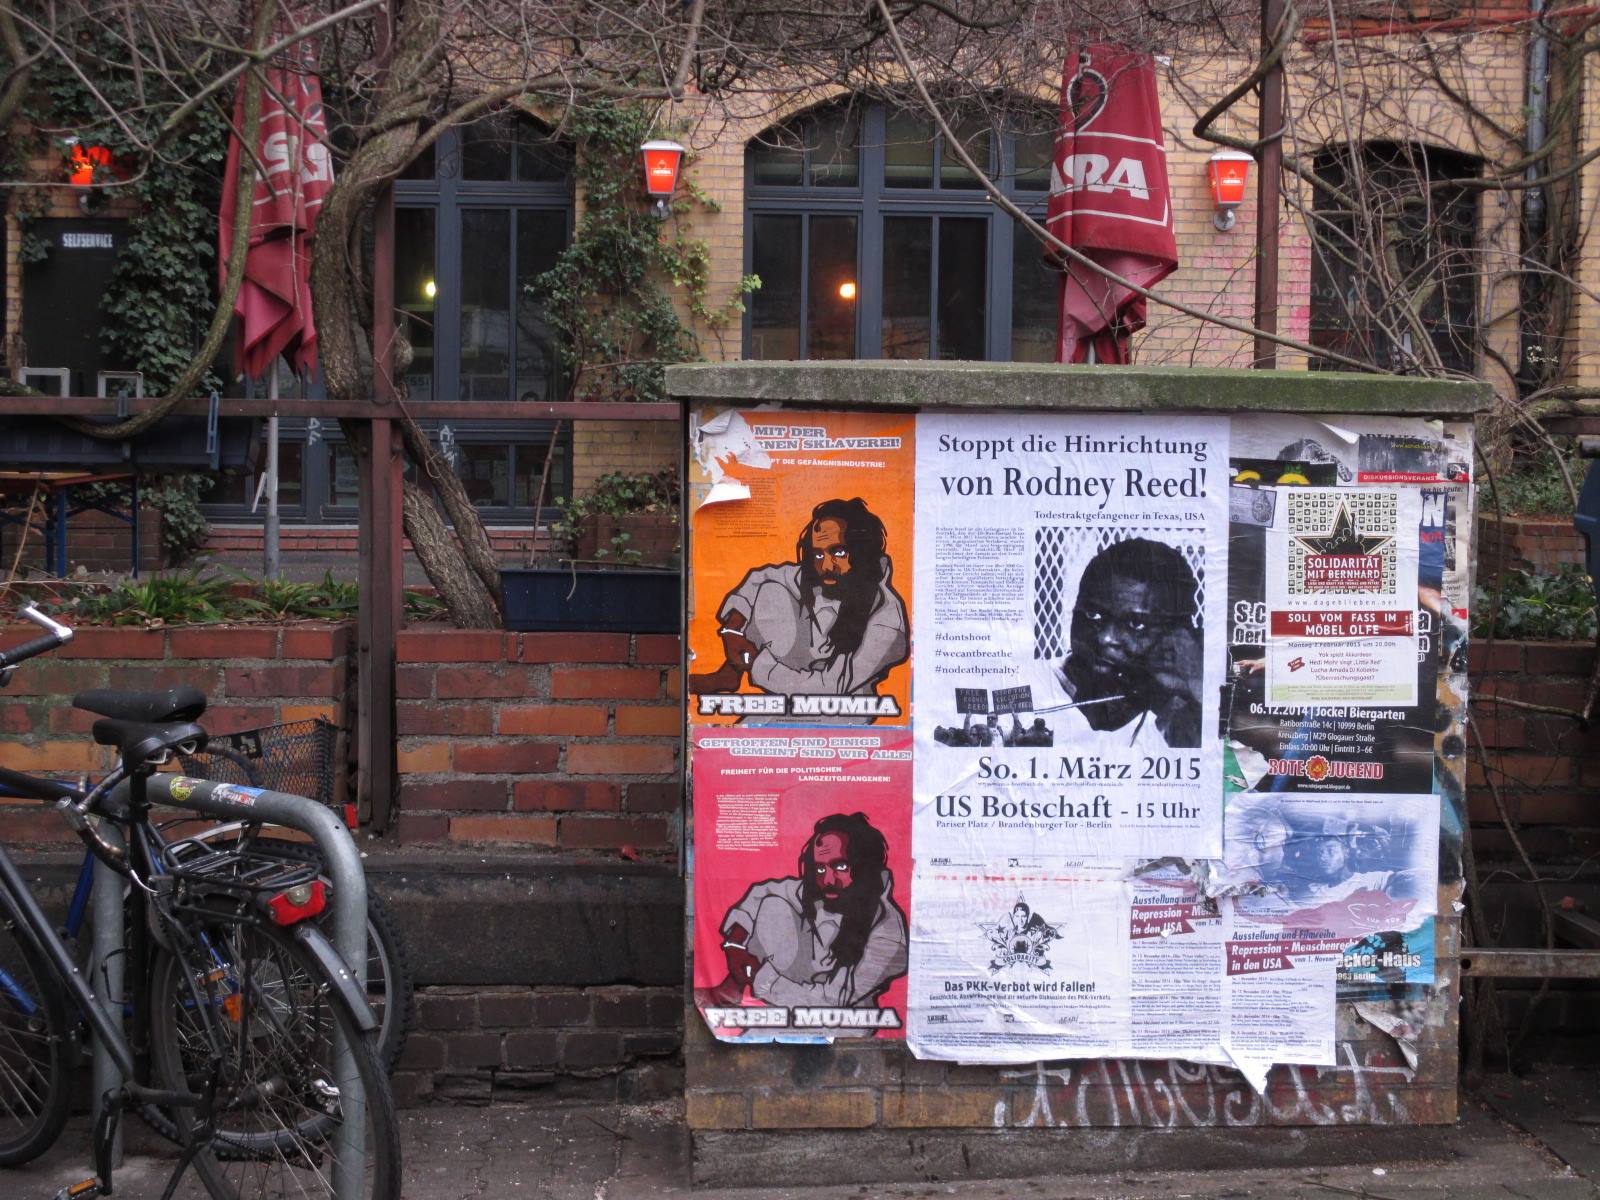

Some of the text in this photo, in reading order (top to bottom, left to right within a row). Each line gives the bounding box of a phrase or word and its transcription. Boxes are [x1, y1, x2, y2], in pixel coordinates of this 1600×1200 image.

[753, 426, 826, 438] MIT DER
[803, 437, 900, 449] SKLAVEREI!
[938, 433, 1208, 462] Stoppt die Hinrichtung
[940, 466, 1208, 509] von Rodney Reed!
[1034, 510, 1206, 523] Todestraktgefangener in Texas, USA
[1308, 556, 1379, 569] SOLIDARITÄT
[1308, 570, 1380, 579] MIT BERNHARD
[1288, 613, 1397, 622] SOLI VOM FASS IM
[1305, 624, 1380, 635] MÖBEL OLFE
[935, 632, 991, 642] #dontshoot
[935, 649, 1012, 658] #wecantbreathe
[700, 695, 900, 715] FREE MUMIA
[1250, 703, 1405, 721] 06.12.2014 Jockel Biergarten
[1357, 722, 1375, 731] Berlin
[700, 738, 880, 748] GETROFFEN SIND EINIGE
[1313, 732, 1327, 740] M29
[1328, 733, 1355, 743] Glogauer
[1356, 733, 1376, 742] Straße
[731, 747, 912, 760] GEMEINT SIND WIR ALLE!
[1319, 744, 1330, 752] Uhr
[1334, 745, 1355, 753] Eintritt
[758, 766, 774, 775] FÜR
[790, 766, 842, 774] POLITISCHEN
[978, 756, 1201, 780] So. 1. März 2015
[1328, 761, 1384, 780] JUGEND
[799, 775, 891, 783] LANGZEITGEFANGENEN!
[936, 794, 1201, 818] US Botschaft 15 Uhr
[936, 820, 966, 828] Pariser
[968, 820, 989, 828] Platz
[998, 820, 1062, 830] Brandenburger
[1086, 820, 1112, 828] Berlin
[1132, 893, 1197, 905] Ausstellung und
[1132, 907, 1182, 922] Repression
[1132, 922, 1182, 934] in den USA
[1232, 928, 1336, 942] Ausstellung und Filmreihe
[1232, 943, 1281, 957] Repression
[1232, 958, 1282, 971] in den USA
[944, 981, 964, 992] Das
[966, 981, 1030, 992] PKK-Verbot
[1034, 981, 1057, 992] wird
[704, 1007, 901, 1028] FREE MUMIA
